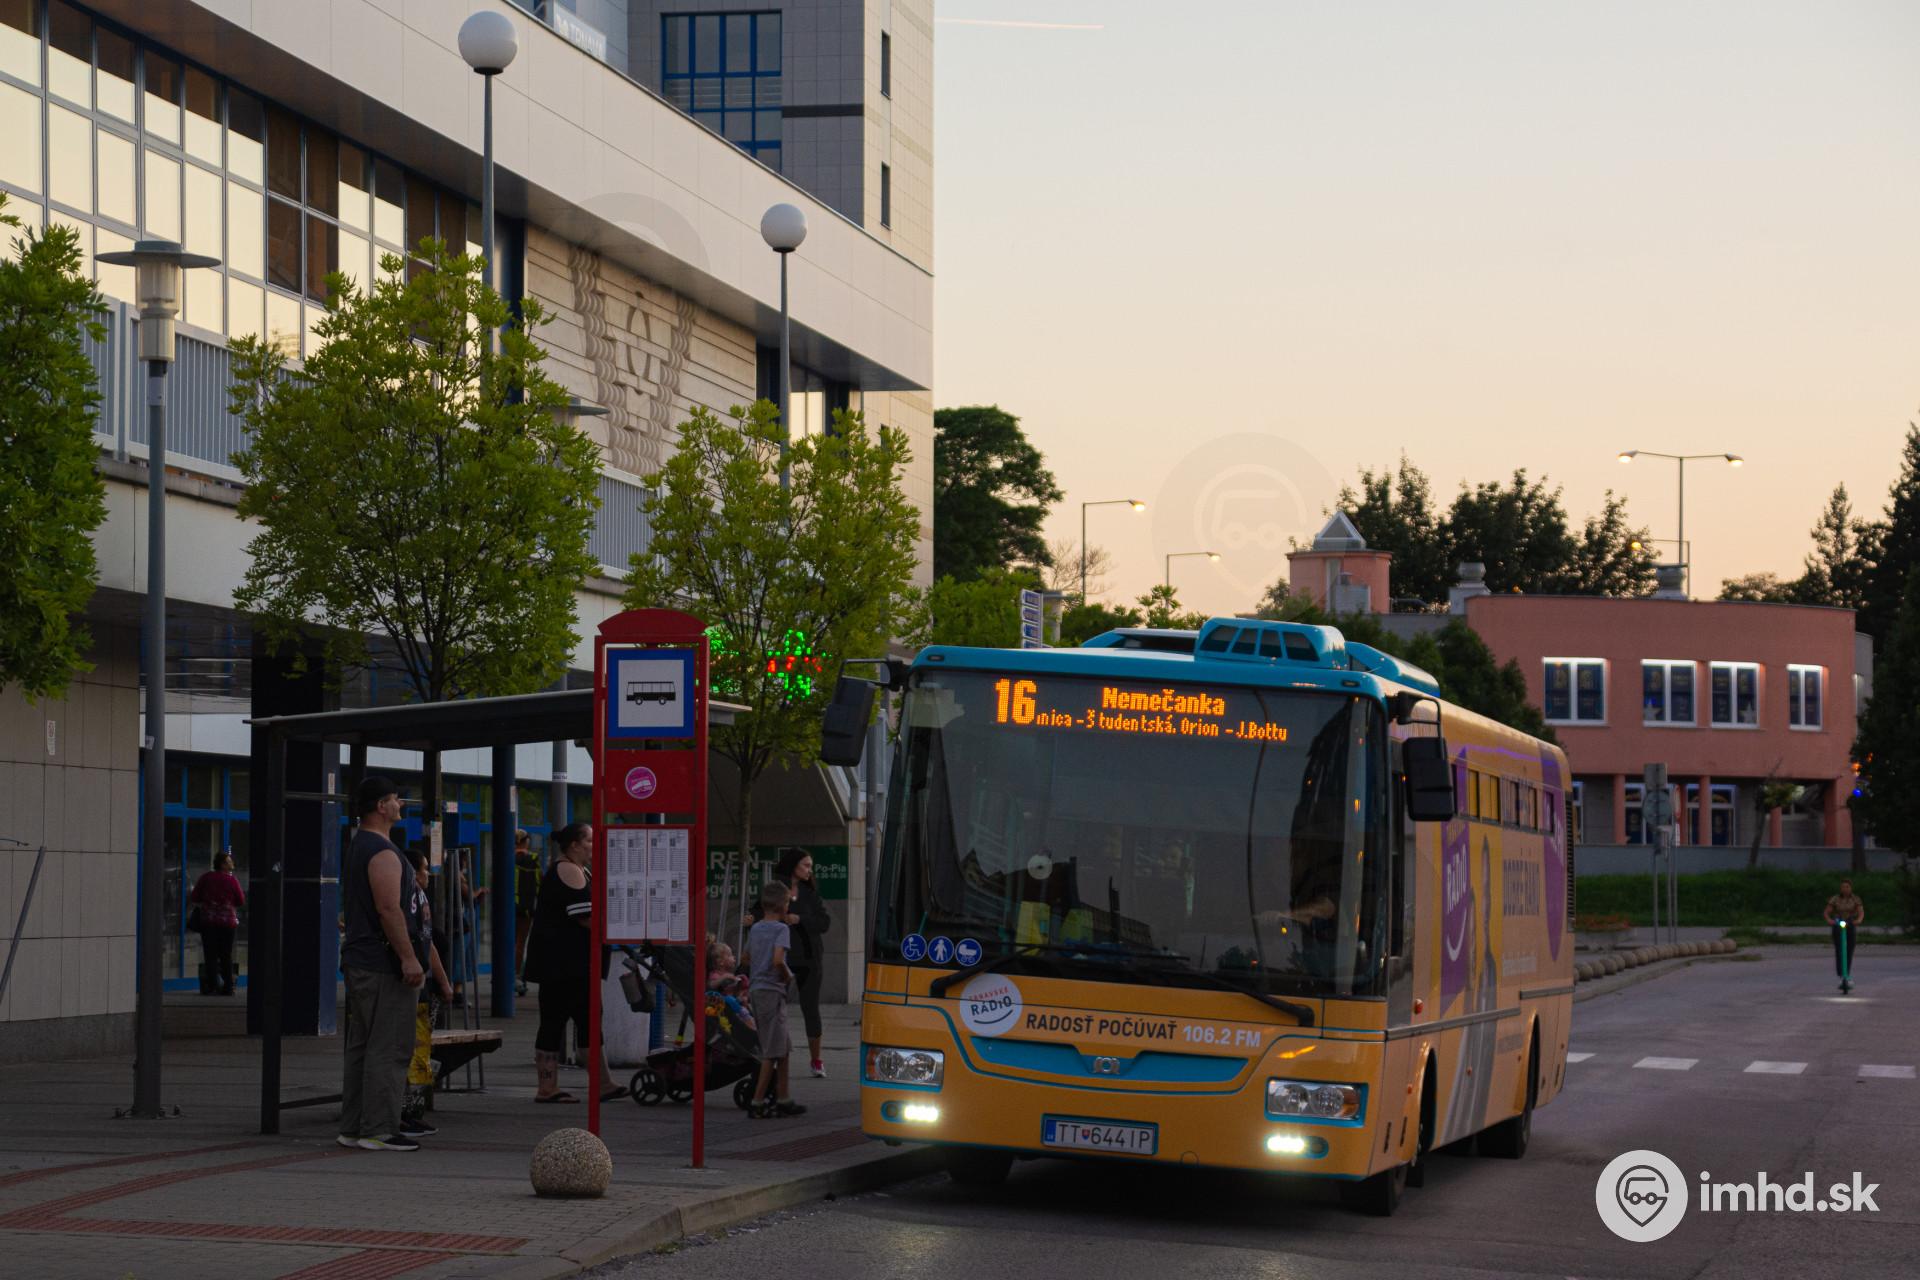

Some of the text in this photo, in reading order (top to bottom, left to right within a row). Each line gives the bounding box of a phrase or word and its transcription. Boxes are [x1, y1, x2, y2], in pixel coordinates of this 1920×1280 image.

[994, 678, 1038, 724] 16
[1102, 687, 1226, 716] Nemečanka
[1180, 716, 1219, 737] Orion
[1235, 720, 1287, 741] J.Bottu
[1025, 1013, 1262, 1048] RADOSŤ POČÚVAŤ 106.2 FM
